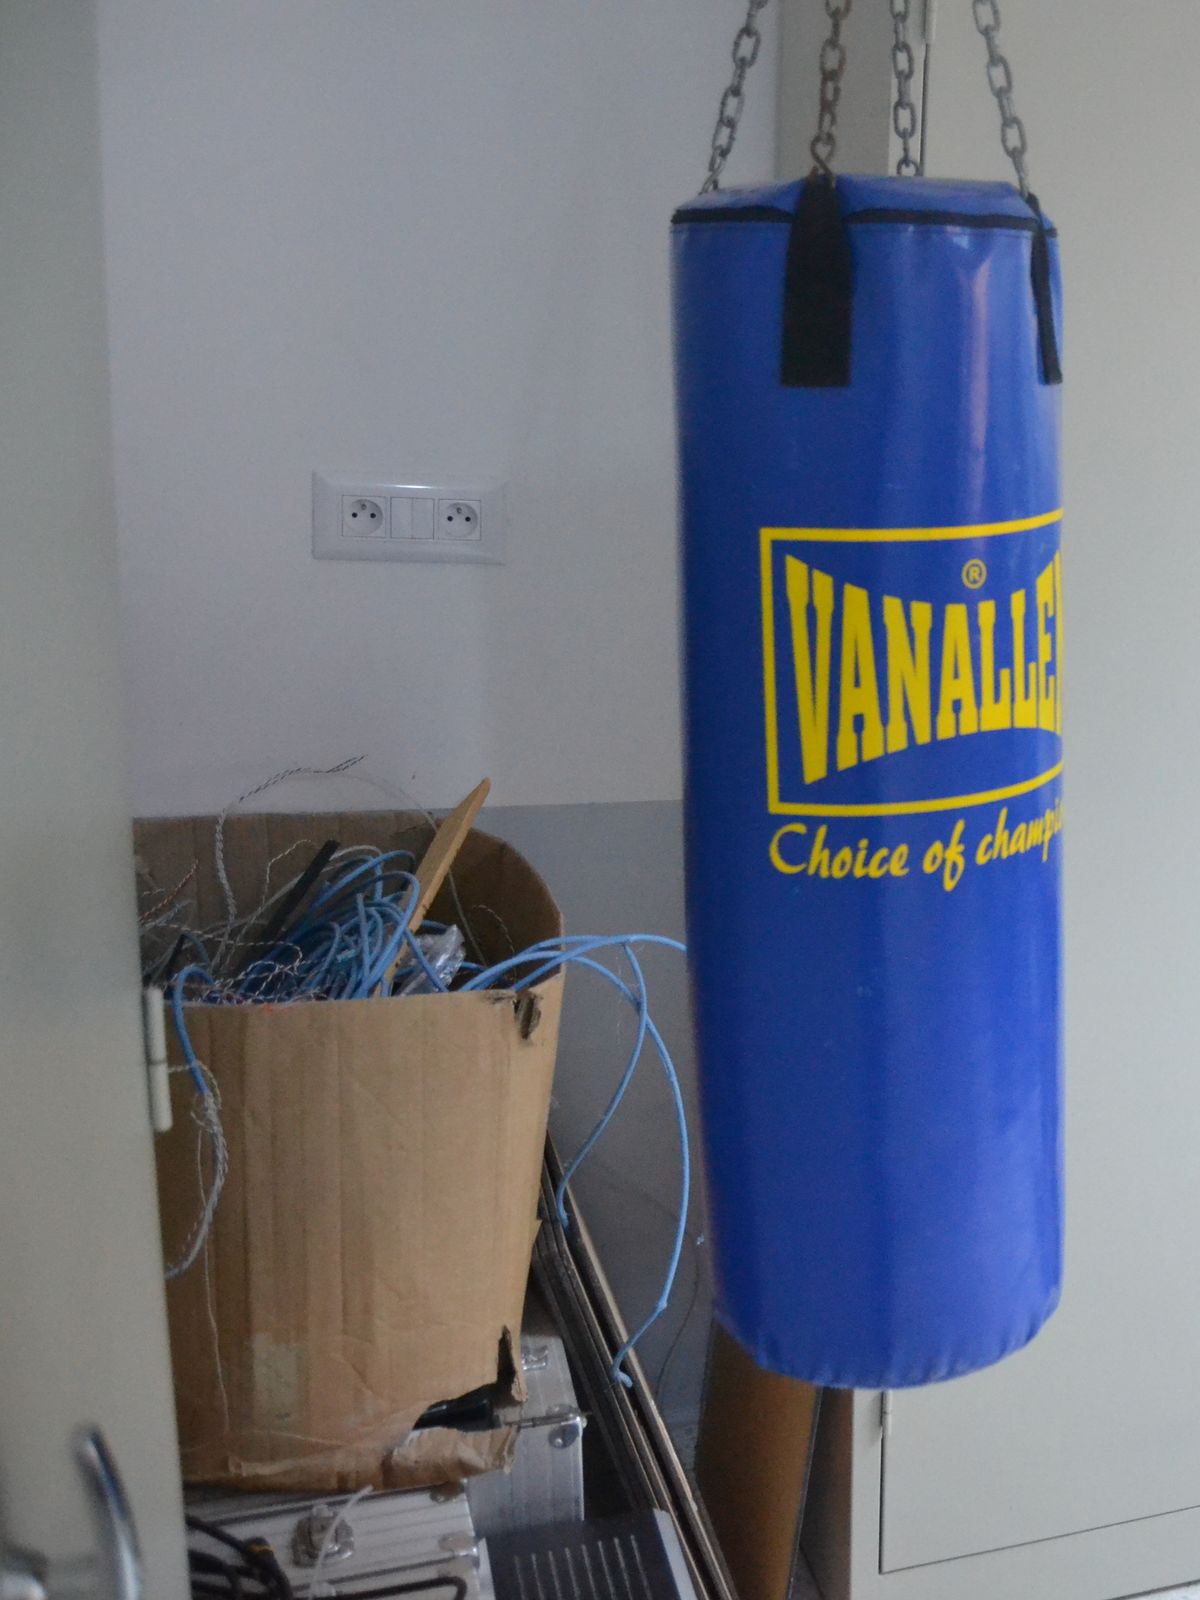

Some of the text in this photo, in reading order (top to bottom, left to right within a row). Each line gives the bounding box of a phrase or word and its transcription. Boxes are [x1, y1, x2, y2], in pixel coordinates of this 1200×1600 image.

[785, 550, 1063, 785] VANALLE
[769, 822, 909, 879] Choice
[922, 819, 966, 892] of
